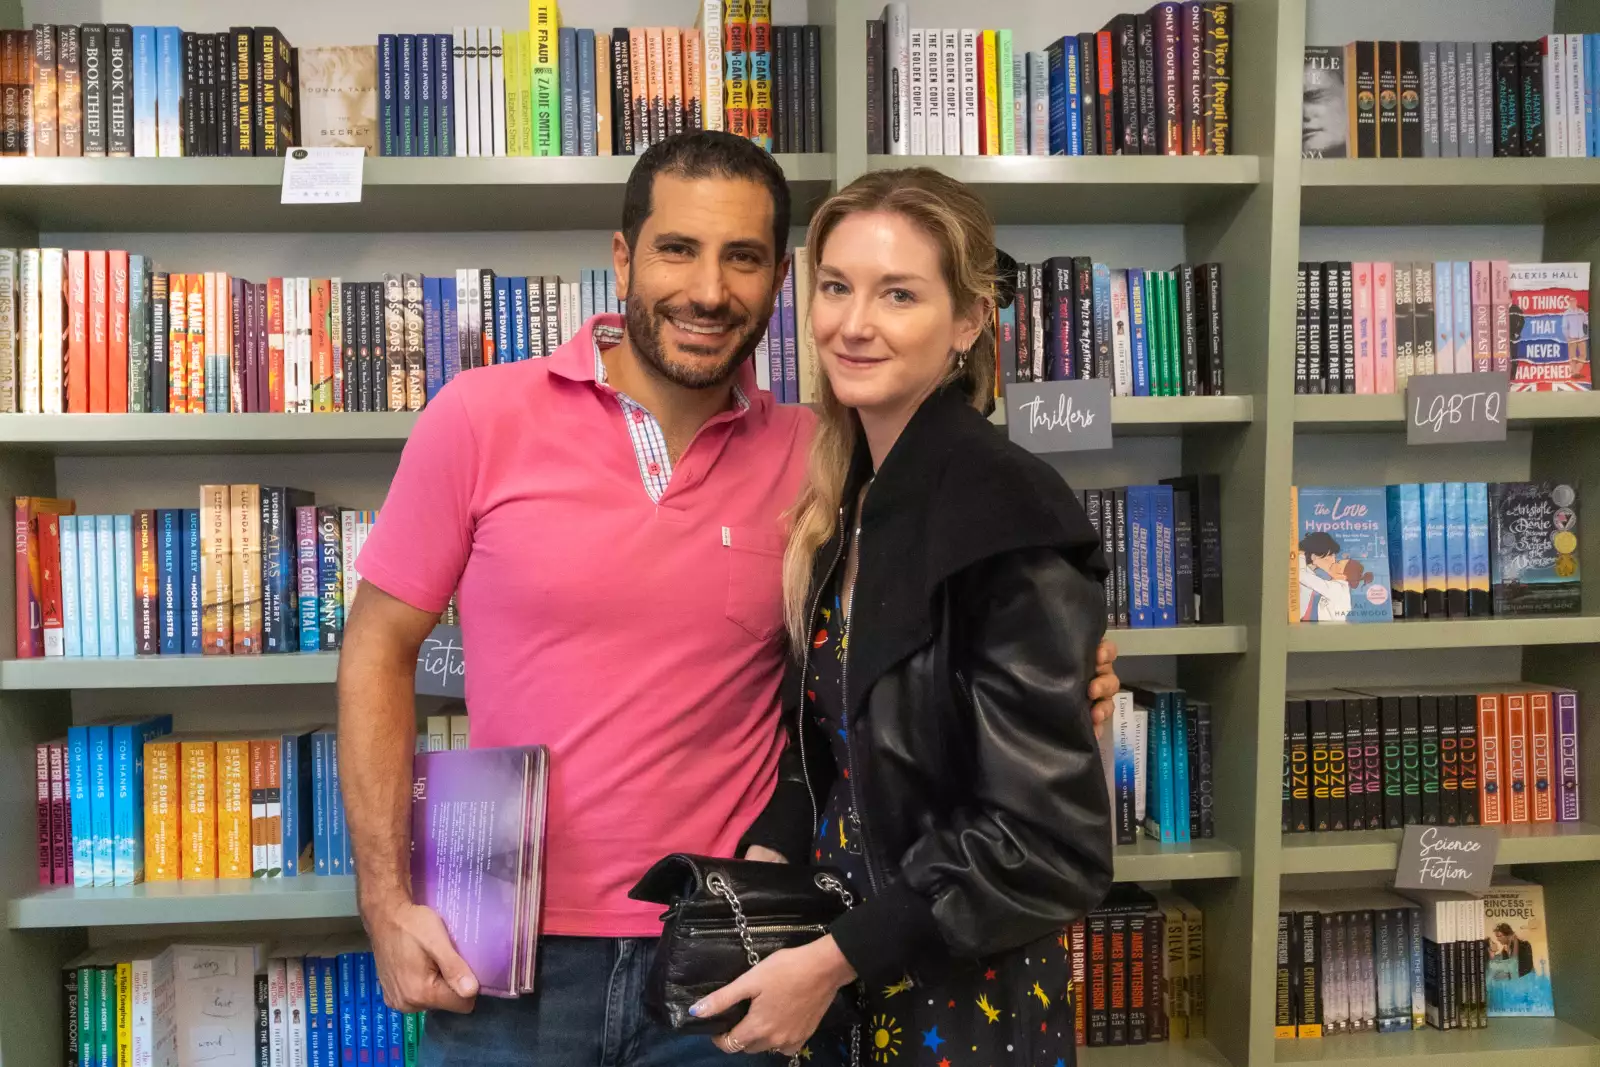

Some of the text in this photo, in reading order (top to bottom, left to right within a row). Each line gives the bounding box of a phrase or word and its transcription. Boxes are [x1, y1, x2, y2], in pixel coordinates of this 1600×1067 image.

[538, 6, 548, 63] THE FRAUD
[1166, 35, 1173, 43] IF
[87, 48, 98, 89] BOOK
[112, 48, 123, 89] BOOK
[913, 52, 921, 82] GOLDEN
[929, 52, 938, 83] GOLDEN
[946, 34, 955, 118] THE GOLDEN COUPLE
[1068, 55, 1076, 94] HOUSEMAID
[1166, 46, 1174, 82] YOU'RE
[1192, 6, 1200, 116] ONLY IF YOU'RE LUCKY
[238, 35, 250, 151] REDWOOD AND WILDFIRE
[264, 35, 275, 151] REDWOOD AND WILDFIRE
[538, 78, 550, 147] ZADIE SMITH
[913, 87, 921, 116] COUPLE
[930, 87, 938, 117] COUPLE
[1167, 85, 1176, 116] LUCKY
[1499, 78, 1508, 143] YANAGIHARA
[1533, 94, 1541, 127] HANYA
[88, 93, 100, 137] THIEF
[113, 93, 125, 137] THIEF
[508, 92, 516, 152] Elizabeth Strout
[624, 132, 632, 152] SING
[546, 283, 556, 312] HELLO
[1133, 286, 1143, 325] HOUSEMAID
[1395, 270, 1403, 305] MUNGO
[1415, 269, 1423, 304] MUNGO
[1423, 270, 1432, 303] YOUNG
[1518, 295, 1570, 309] 10 THINGS
[499, 316, 507, 349] EDWARD
[1297, 270, 1306, 380] PAGEBOY ELLIOT PAGE
[1310, 270, 1320, 380] PAGEBOY ELLIOT PAGE
[1328, 270, 1339, 379] PAGEBOY ELLIOT PAGE
[1530, 320, 1556, 334] THAT
[771, 338, 782, 381] KATE MYERS
[1526, 344, 1560, 358] NEVER
[391, 364, 401, 412] FRANZEN
[1515, 365, 1572, 379] HAPPENED
[1019, 393, 1095, 433] Thrillers
[1415, 392, 1500, 432] LGBTQ
[1305, 520, 1379, 533] Hypothesis
[1314, 497, 1368, 520] the Love
[1507, 501, 1555, 516] Aristotle
[1509, 518, 1551, 533] Dante
[16, 521, 26, 555] LUCKY
[269, 535, 280, 577] ATLAS
[323, 516, 335, 564] LOUISE
[1516, 536, 1552, 551] Secrets
[301, 539, 316, 632] GIRL GONE VIRAL
[216, 606, 224, 632] SISTER
[324, 584, 335, 628] PENNY
[97, 764, 105, 799] HANKS
[159, 757, 168, 814] LOVE SONGS
[1292, 751, 1308, 799] DUNE
[1314, 750, 1329, 798] DUNE
[1330, 750, 1345, 798] DUNE
[1348, 747, 1363, 793] DUNE
[37, 748, 49, 868] POSTER GIRL VERONICA ROTH
[51, 748, 63, 868] POSTER GIRL VERONICA ROTH
[1420, 828, 1481, 856] Science
[1419, 856, 1472, 886] Fiction
[1484, 900, 1524, 908] RINCESS
[1073, 934, 1084, 983] DAN BROWN
[1168, 927, 1182, 962] SILVA
[1188, 925, 1201, 960] SILVA
[1092, 934, 1104, 1010] JAMES PATTERSON
[1111, 933, 1123, 1008] JAMES PATTERSON
[1131, 932, 1144, 1008] JAMES PATTERSON
[69, 995, 78, 1053] DEAN KOONTZ
